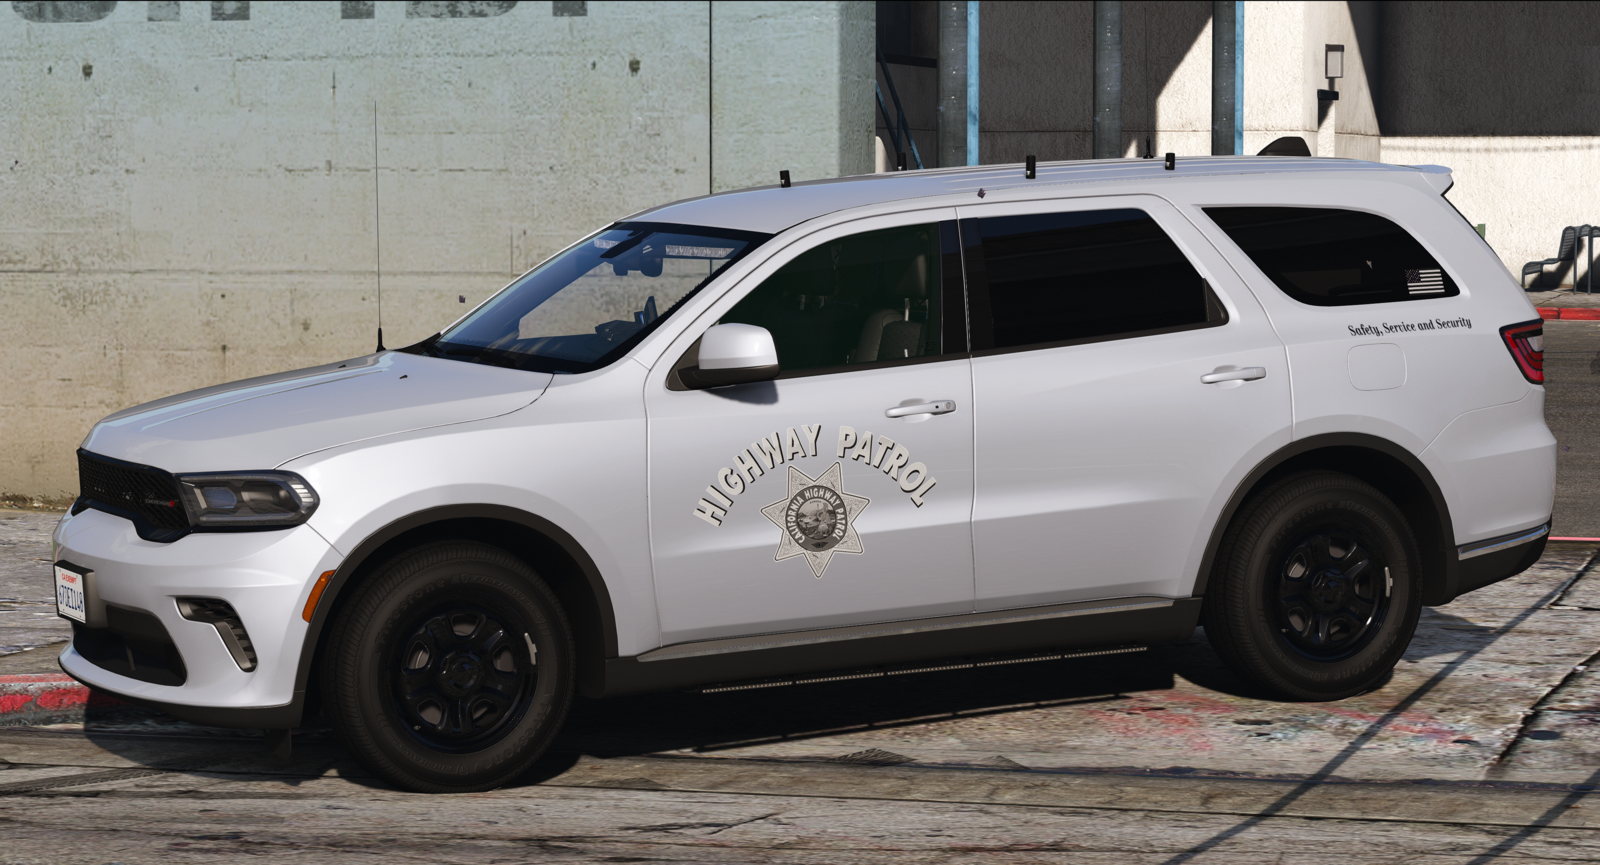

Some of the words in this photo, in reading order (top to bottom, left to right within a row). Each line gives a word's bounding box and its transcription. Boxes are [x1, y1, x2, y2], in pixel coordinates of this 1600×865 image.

[1347, 323, 1384, 337] Safety,
[1382, 321, 1416, 334] Service
[1417, 319, 1436, 331] and
[1435, 316, 1472, 330] Security
[692, 423, 821, 528] HIGHWAY
[837, 425, 937, 508] PATROL
[787, 495, 805, 544] CALIFORNIA
[804, 487, 841, 507] HIGHWAY
[832, 507, 846, 540] PATROL
[1269, 500, 1334, 548] Firestone
[374, 578, 445, 645] Firestone
